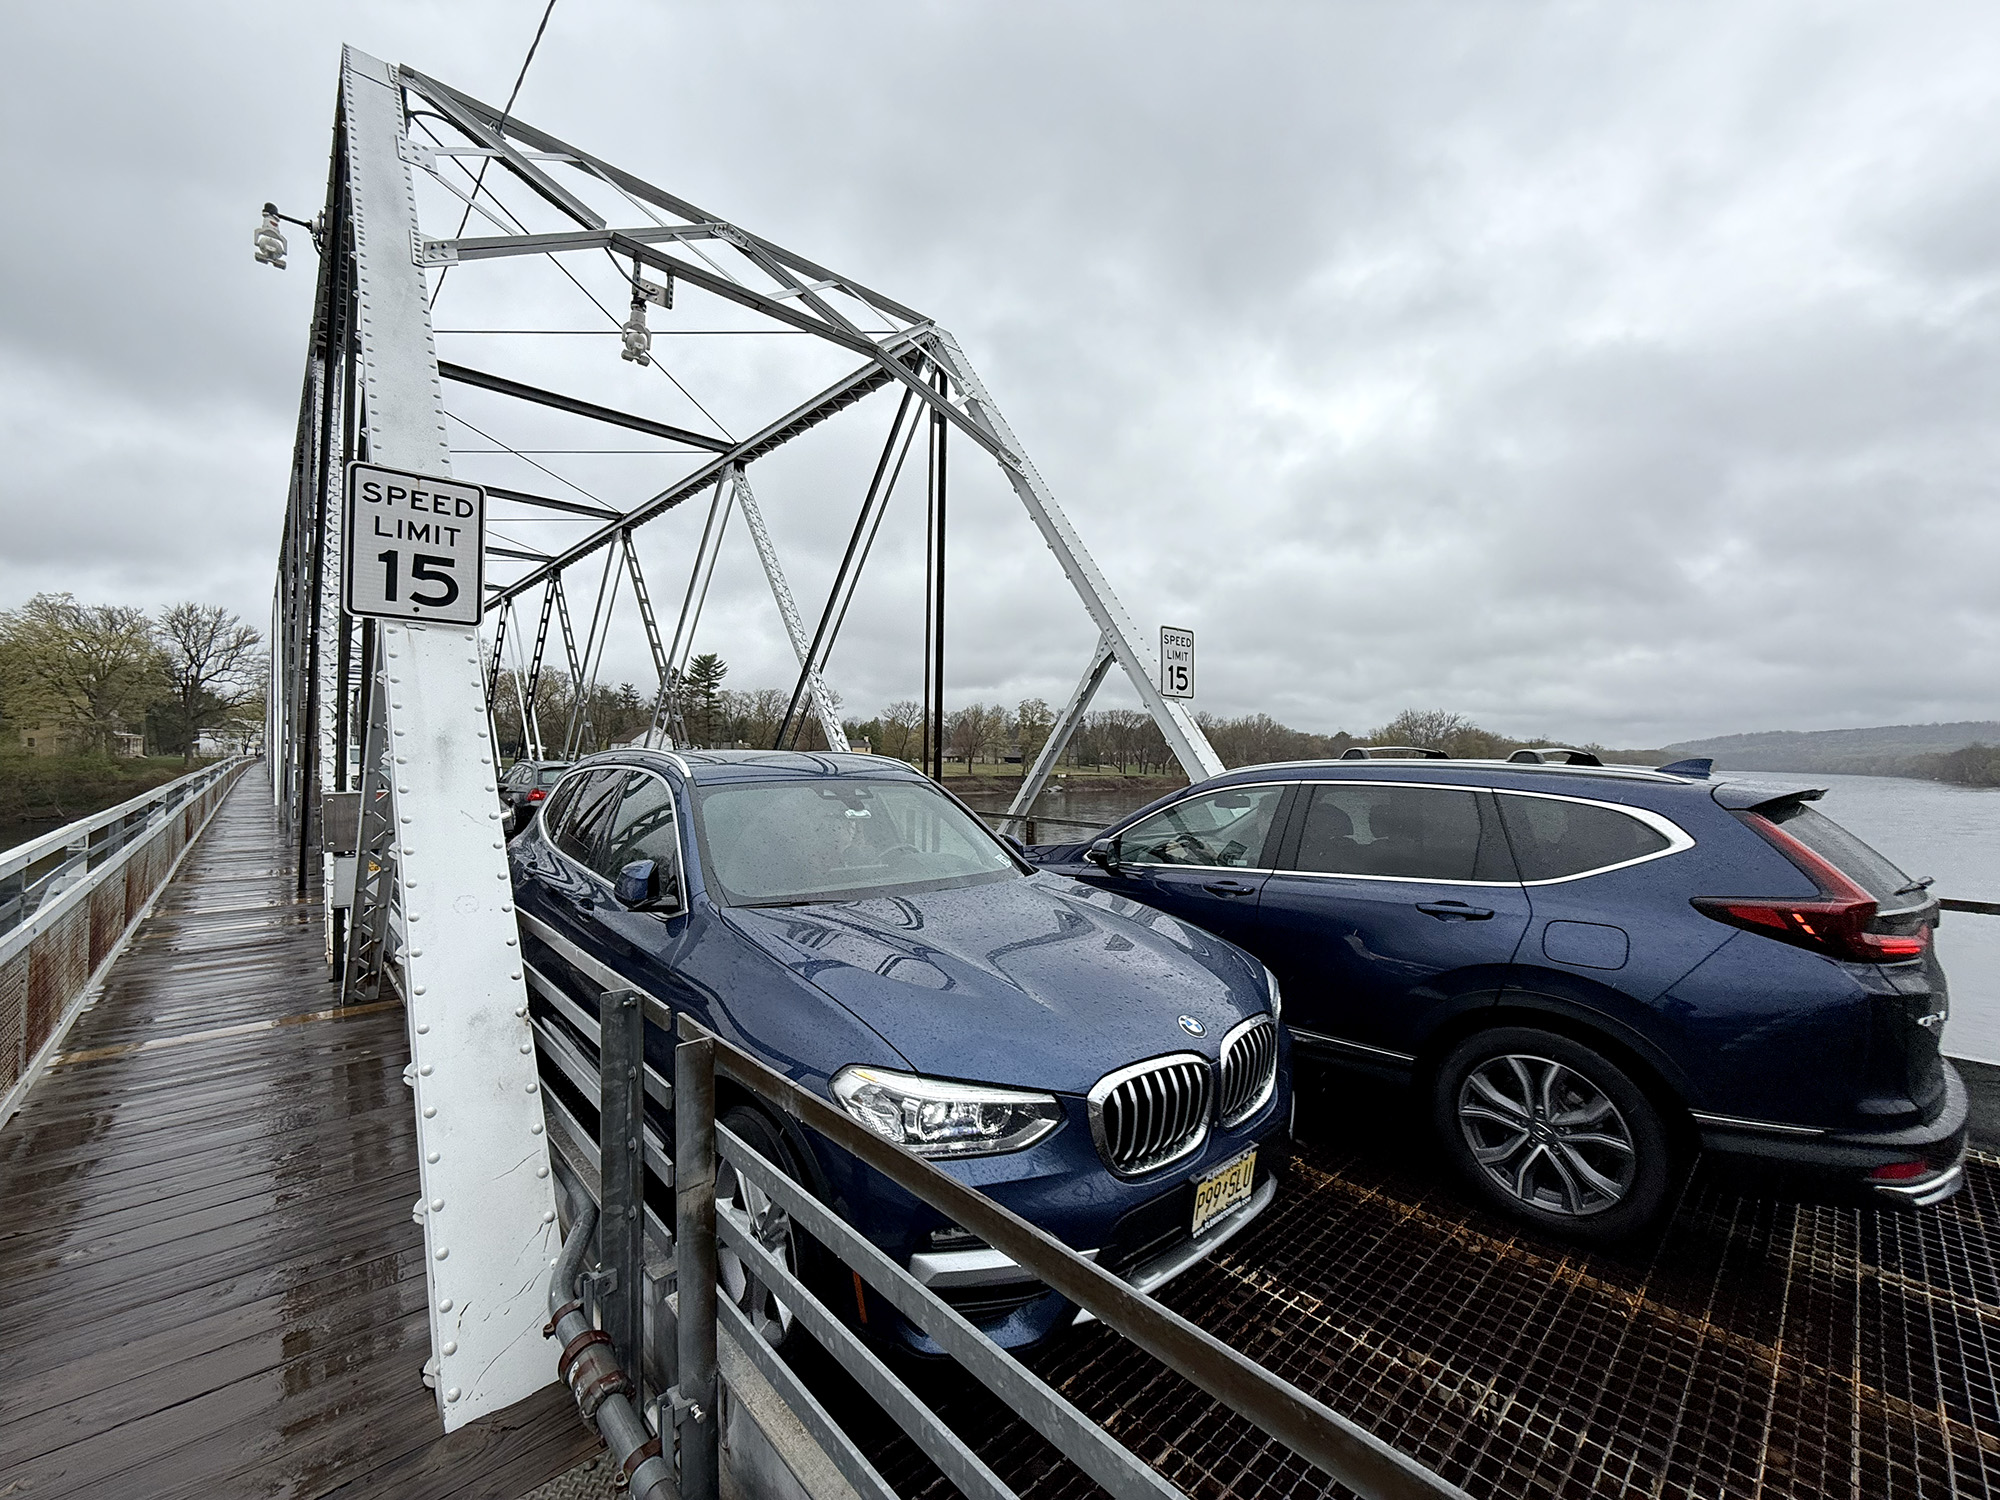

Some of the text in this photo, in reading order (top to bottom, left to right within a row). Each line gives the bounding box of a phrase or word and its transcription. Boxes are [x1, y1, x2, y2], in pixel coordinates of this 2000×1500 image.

[362, 482, 474, 518] SPEED
[374, 515, 461, 547] LIMIT
[377, 550, 459, 607] 15
[1164, 634, 1191, 648] SPEED
[1167, 649, 1189, 662] LIMIT
[1168, 665, 1189, 691] 15
